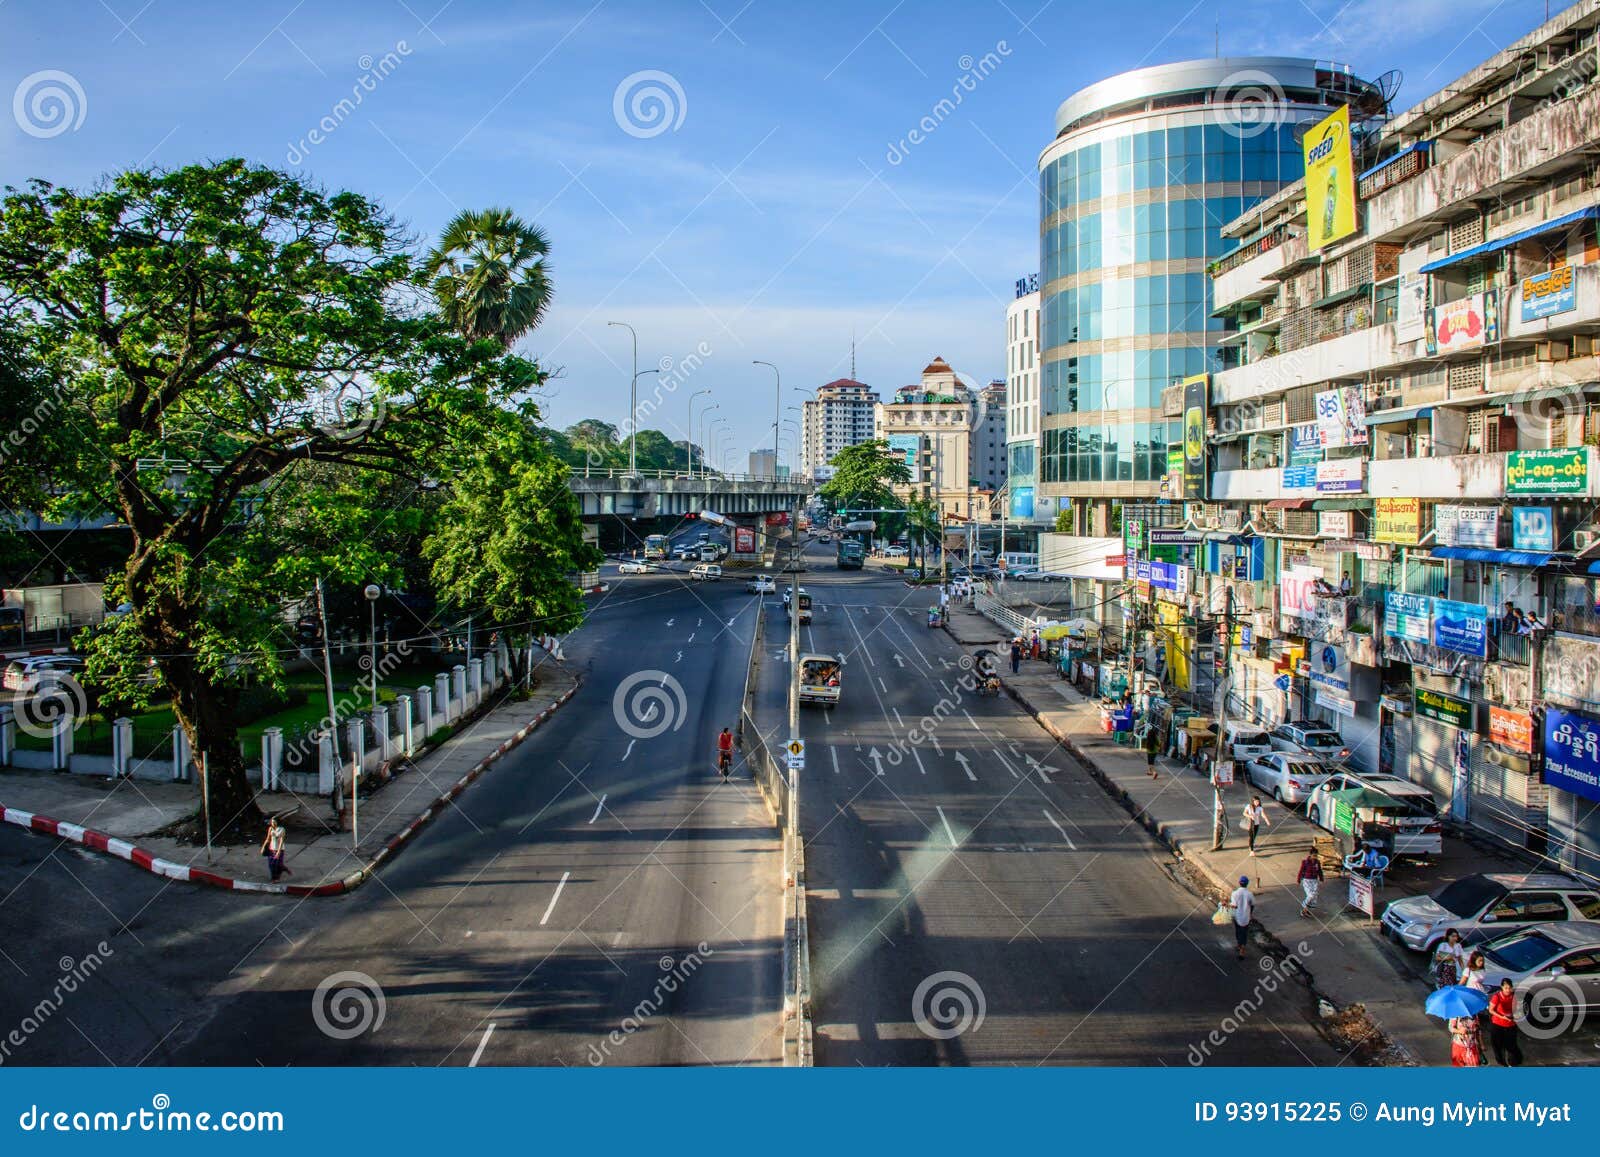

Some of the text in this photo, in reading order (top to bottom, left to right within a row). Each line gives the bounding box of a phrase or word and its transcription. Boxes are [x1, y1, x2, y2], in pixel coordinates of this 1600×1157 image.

[1307, 136, 1334, 167] SPEED
[1460, 510, 1495, 521] CREATIVE
[1519, 512, 1547, 535] HD
[1281, 577, 1314, 612] KLC
[1388, 593, 1426, 611] CREATIVE
[1465, 616, 1482, 632] HD
[1546, 757, 1598, 786] Phone Accessories
